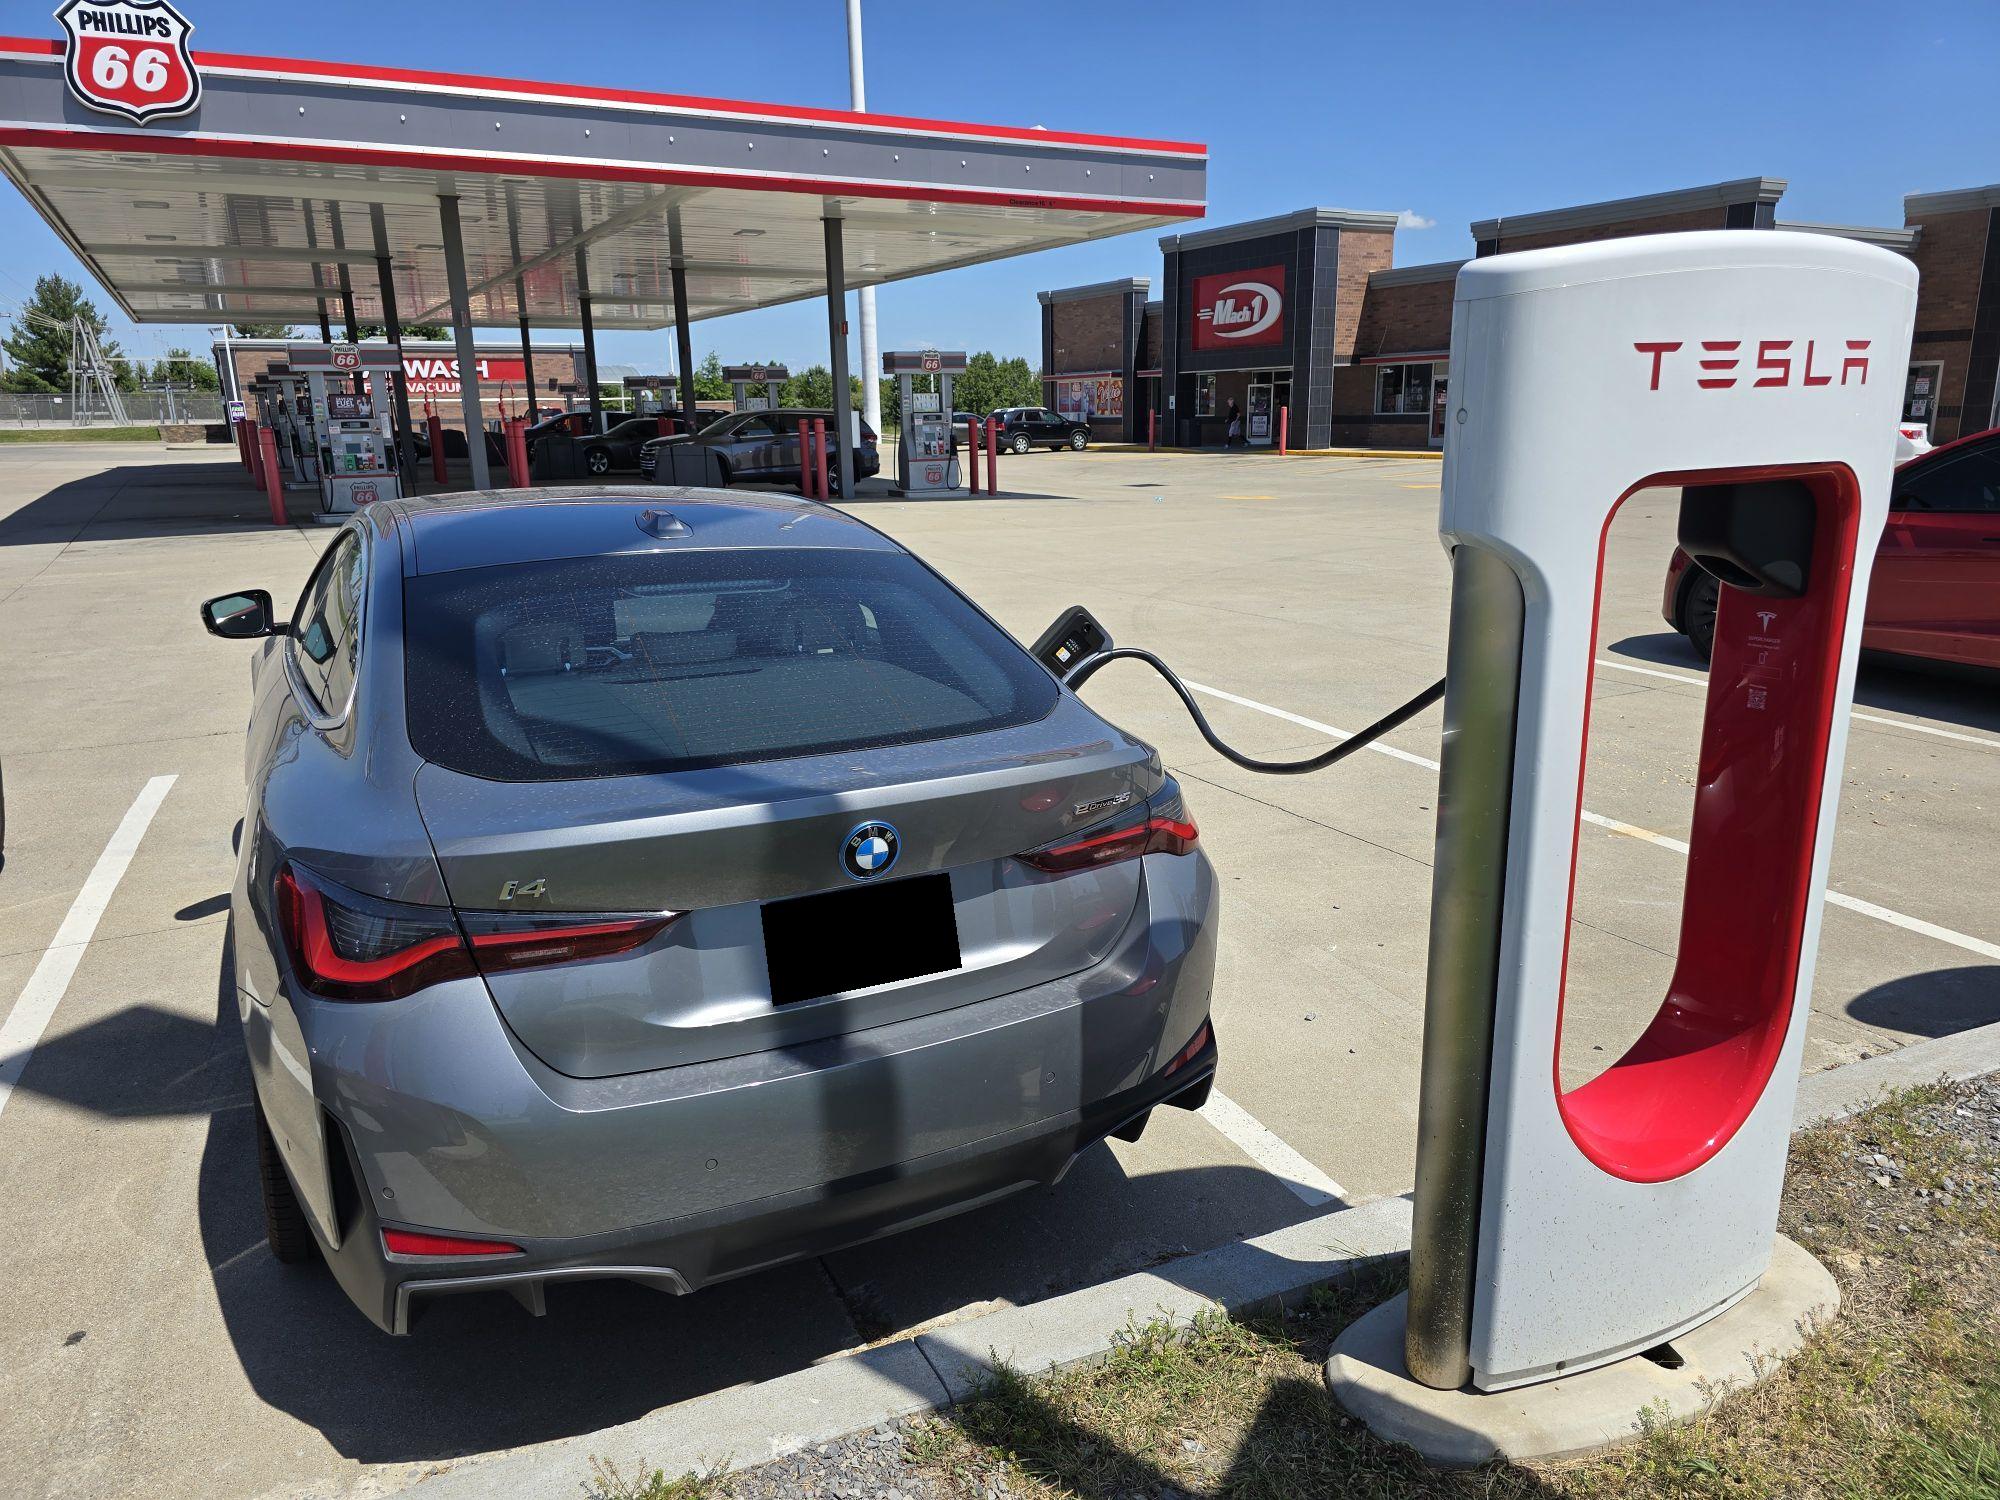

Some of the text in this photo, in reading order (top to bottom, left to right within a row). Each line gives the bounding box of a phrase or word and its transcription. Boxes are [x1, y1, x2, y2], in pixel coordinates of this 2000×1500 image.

[78, 10, 171, 38] PHILLIPS
[92, 45, 170, 92] 66
[1212, 295, 1263, 325] Mach 1
[336, 354, 356, 366] 66
[925, 360, 939, 369] 66
[1633, 340, 1871, 391] TESLA
[928, 472, 941, 481] 66
[356, 491, 374, 501] 66
[499, 879, 546, 901] i4
